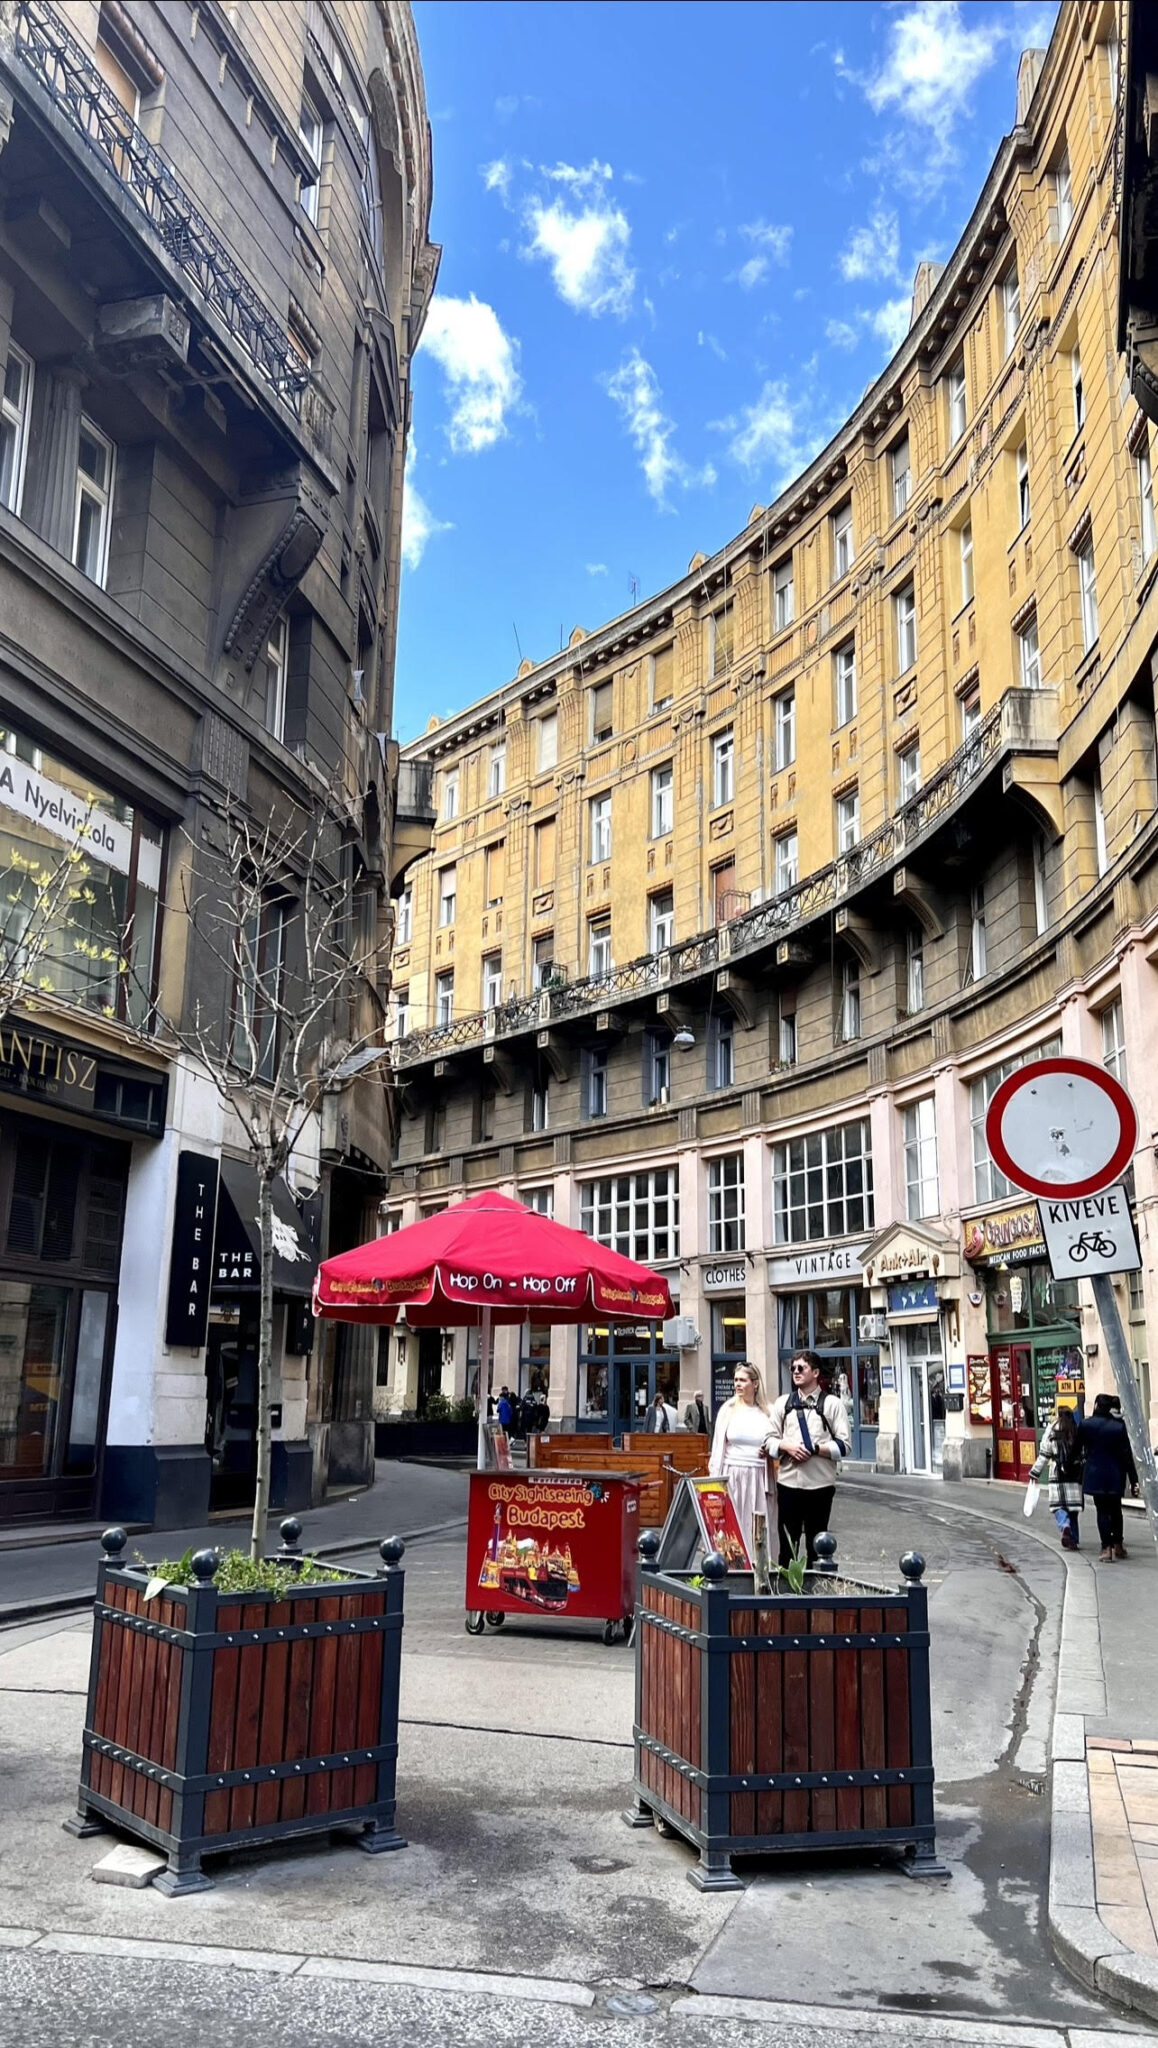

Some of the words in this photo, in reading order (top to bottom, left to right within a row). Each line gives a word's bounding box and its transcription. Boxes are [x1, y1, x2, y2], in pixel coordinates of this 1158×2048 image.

[194, 1184, 205, 1241] THE
[1049, 1196, 1120, 1224] KIVEVE
[220, 1252, 253, 1263] THE
[795, 1252, 851, 1275] VINTAGE
[1012, 1248, 1027, 1259] FOOD
[218, 1268, 252, 1278] BAR
[450, 1273, 478, 1291] Hop
[483, 1272, 502, 1289] On
[523, 1276, 551, 1293] Hop
[555, 1276, 577, 1292] Off
[706, 1267, 746, 1285] CLOTHES
[188, 1257, 200, 1316] BAR
[1061, 1382, 1072, 1390] ATM
[488, 1483, 515, 1502] City
[514, 1484, 594, 1506] Sightseeing
[507, 1504, 585, 1531] Budapest
